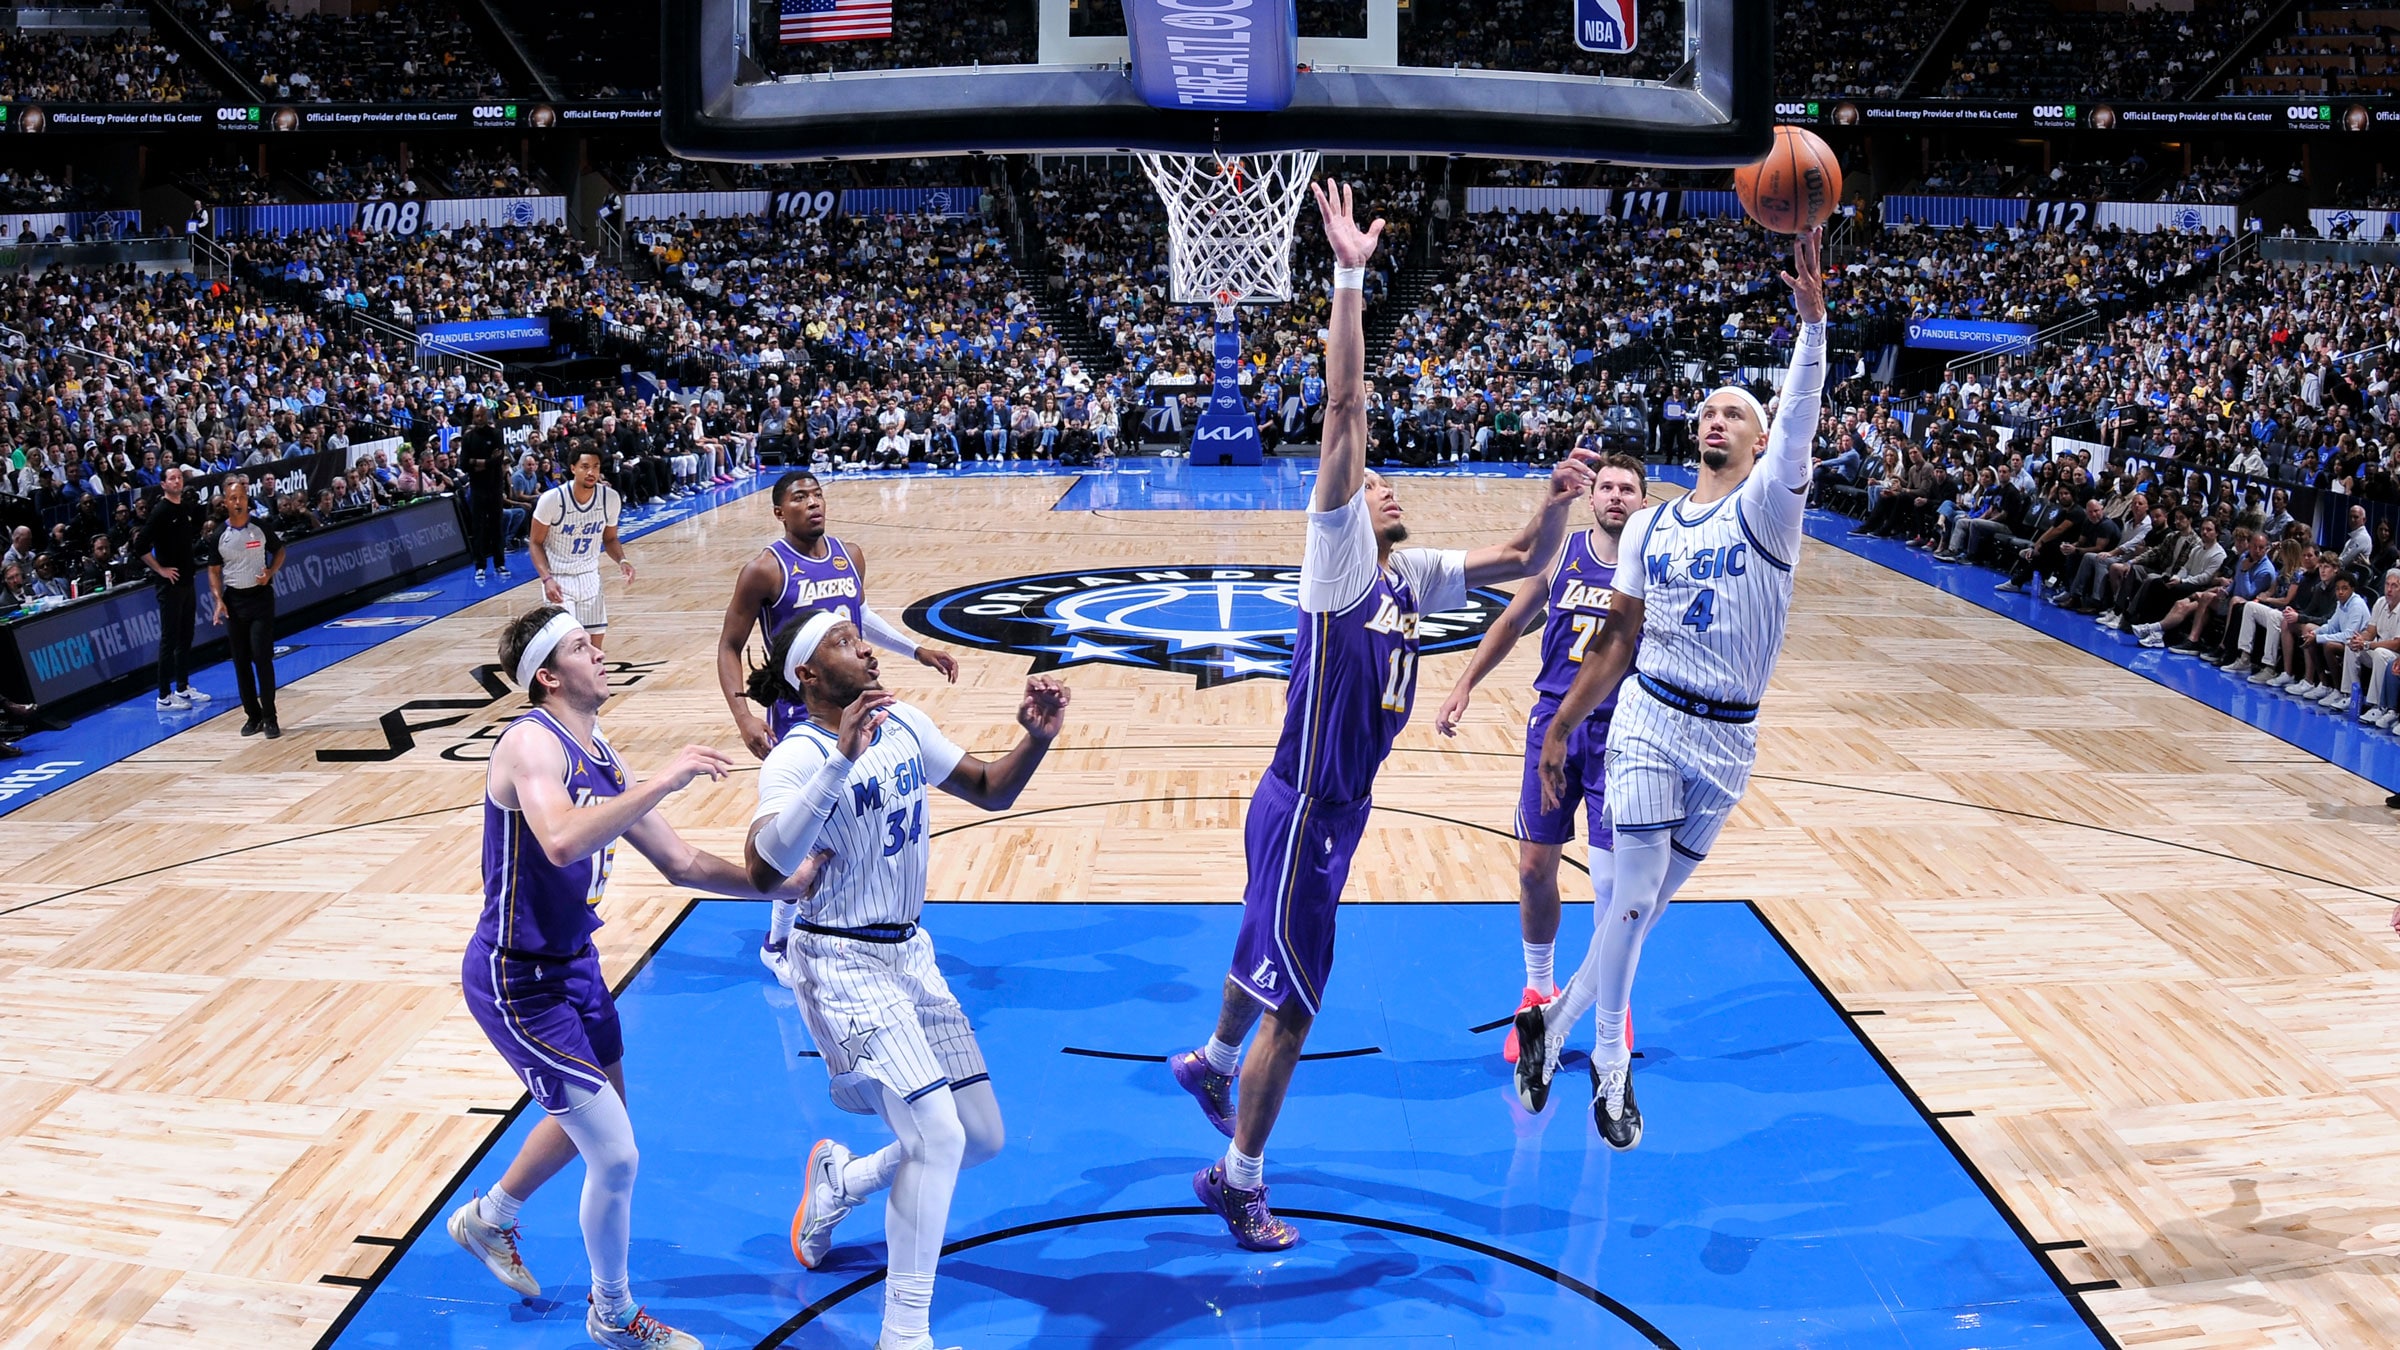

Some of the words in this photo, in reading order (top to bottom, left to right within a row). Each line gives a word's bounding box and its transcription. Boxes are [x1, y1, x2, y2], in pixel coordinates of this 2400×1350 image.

[1584, 20, 1614, 43] NBA
[217, 107, 247, 120] OUC
[472, 106, 503, 118] OUC
[563, 110, 591, 119] Official
[593, 110, 619, 120] Energy
[620, 109, 651, 118] Provider
[653, 109, 662, 117] of
[1774, 103, 1806, 115] OUC
[1867, 109, 1894, 118] Official
[1896, 110, 1921, 119] Energy
[1923, 109, 1953, 118] Provider
[1955, 110, 1964, 118] of
[1965, 110, 1977, 118] the
[1979, 110, 1991, 118] Kia
[1993, 110, 2018, 119] Center
[2033, 105, 2063, 118] OUC
[2123, 112, 2150, 121] Official
[2152, 112, 2177, 122] Energy
[2179, 112, 2210, 121] Provider
[2211, 112, 2220, 121] of
[2220, 112, 2233, 121] the
[2234, 112, 2246, 120] Kia
[2247, 112, 2272, 121] Center
[2287, 106, 2318, 119] OUC
[2376, 112, 2400, 121] Officia
[53, 113, 79, 123] Official
[81, 114, 105, 125] Energy
[107, 113, 139, 123] Provider
[140, 113, 149, 122] of
[149, 113, 162, 122] the
[163, 113, 176, 122] Kia
[177, 114, 202, 122] Center
[307, 113, 334, 122] Official
[336, 113, 361, 123] Energy
[363, 113, 394, 121] Provider
[395, 113, 403, 121] of
[404, 113, 417, 121] the
[418, 112, 430, 120] Kia
[432, 112, 458, 121] Center
[776, 191, 835, 219] 109
[1622, 191, 1669, 219] 111
[361, 201, 420, 235] 108
[2036, 201, 2086, 233] 112
[435, 332, 474, 344] FANDUEL
[475, 329, 505, 341] SPORTS
[506, 327, 544, 339] NETWORK
[1922, 328, 1959, 340] FANDUEL
[1960, 332, 1991, 342] SPORTS
[571, 538, 592, 554] 13
[29, 633, 95, 682] WATCH
[89, 622, 127, 661] THE
[124, 606, 160, 649] MAG
[286, 562, 306, 595] ON
[324, 549, 378, 577] FANDUEL
[375, 535, 413, 558] SPORTS
[412, 519, 456, 547] NETWORK
[793, 577, 857, 609] LAKERS
[1557, 579, 1612, 610] LAKE
[1682, 589, 1715, 633] 4
[1381, 648, 1416, 713] 11
[883, 800, 923, 857] 34
[1251, 954, 1278, 991] LA
